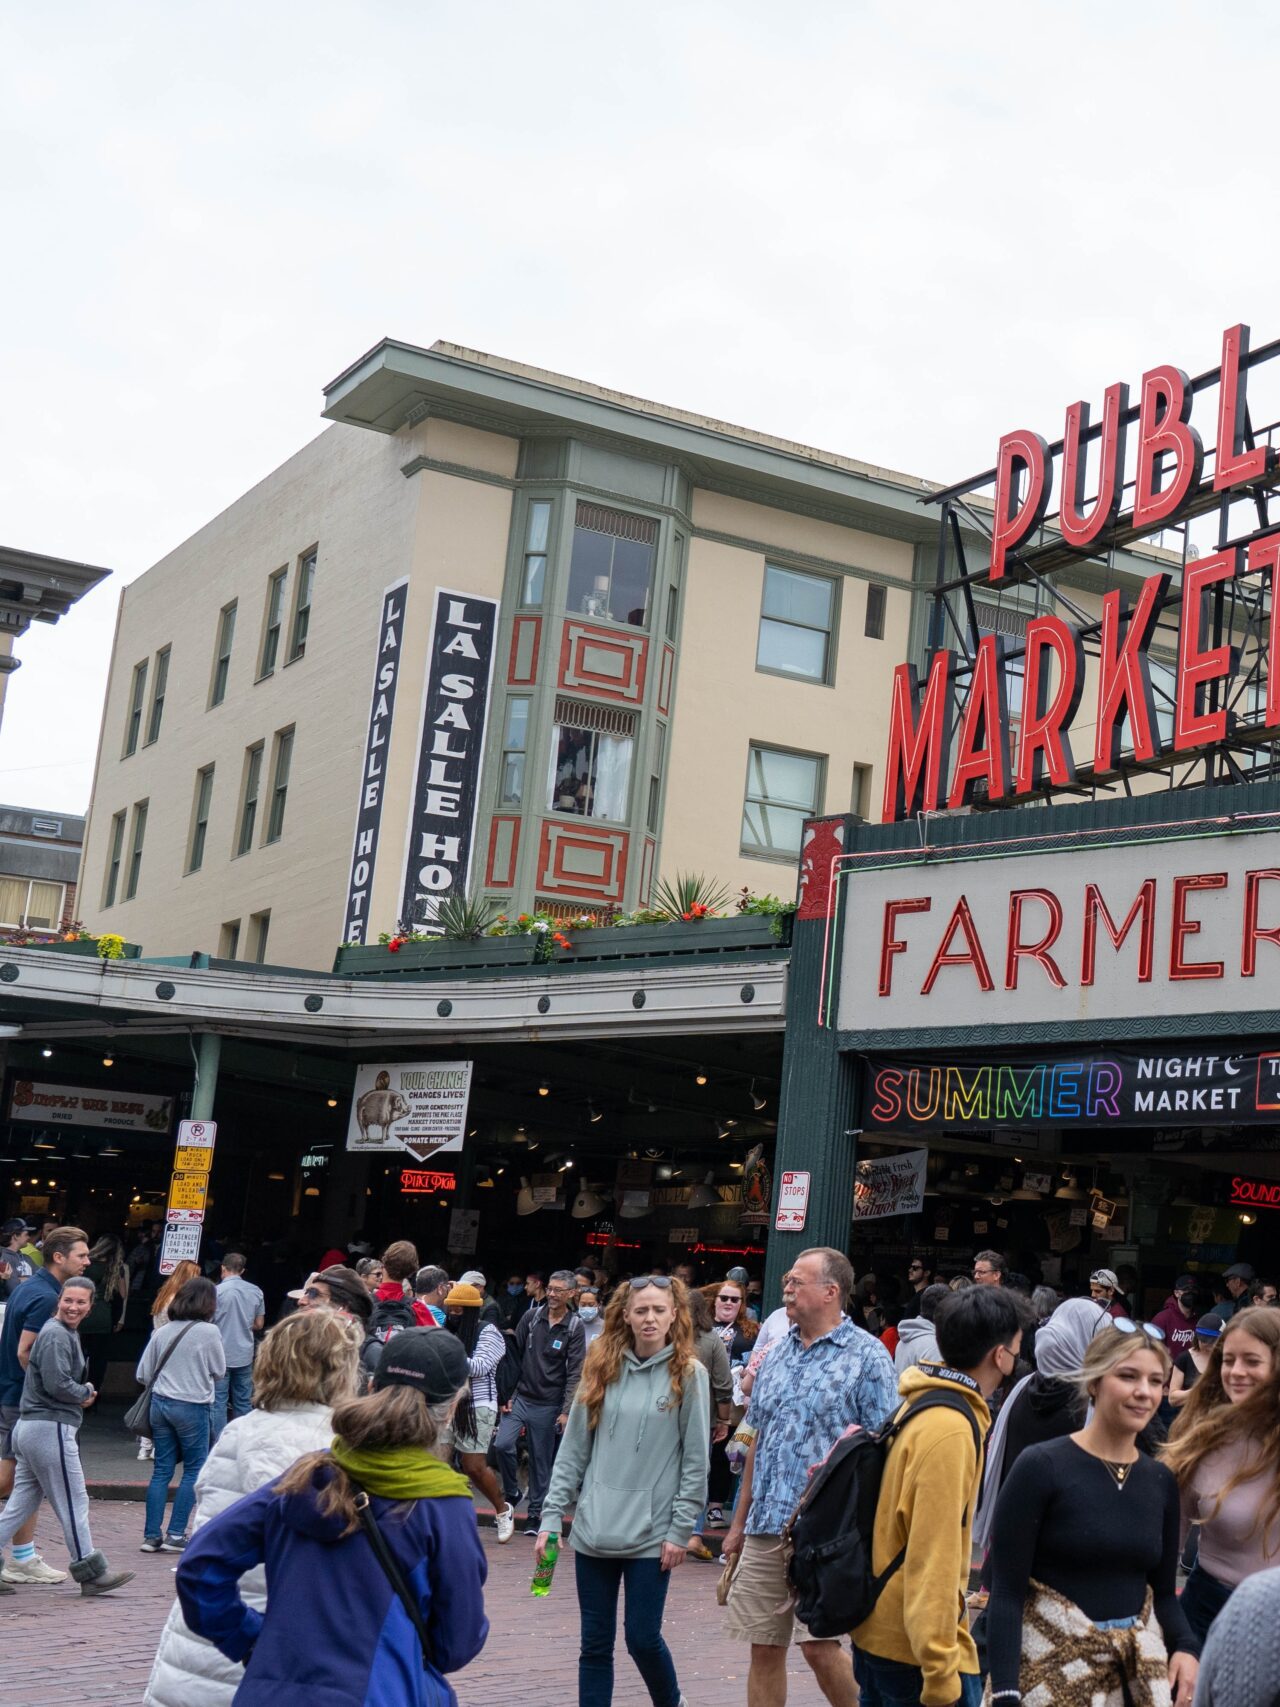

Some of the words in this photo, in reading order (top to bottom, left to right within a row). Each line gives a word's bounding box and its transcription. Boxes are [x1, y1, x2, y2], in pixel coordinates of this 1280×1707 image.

[381, 597, 400, 654] LA
[442, 600, 482, 660] LA
[363, 662, 395, 810] SALLE
[423, 674, 475, 818] SALLE
[1137, 1056, 1219, 1079] NIGHT
[400, 1071, 427, 1090] YOUR
[427, 1071, 468, 1090] CHANGE
[872, 1061, 1122, 1122] SUMMER
[409, 1091, 441, 1099] CHANGES
[443, 1091, 466, 1099] LIVES!
[1134, 1088, 1241, 1112] MARKET
[52, 1112, 73, 1120] DRIED
[104, 1117, 135, 1126] PRODUCE
[783, 1174, 792, 1183] NO
[784, 1186, 805, 1196] STOPS
[938, 1367, 977, 1389] HOLLISTER
